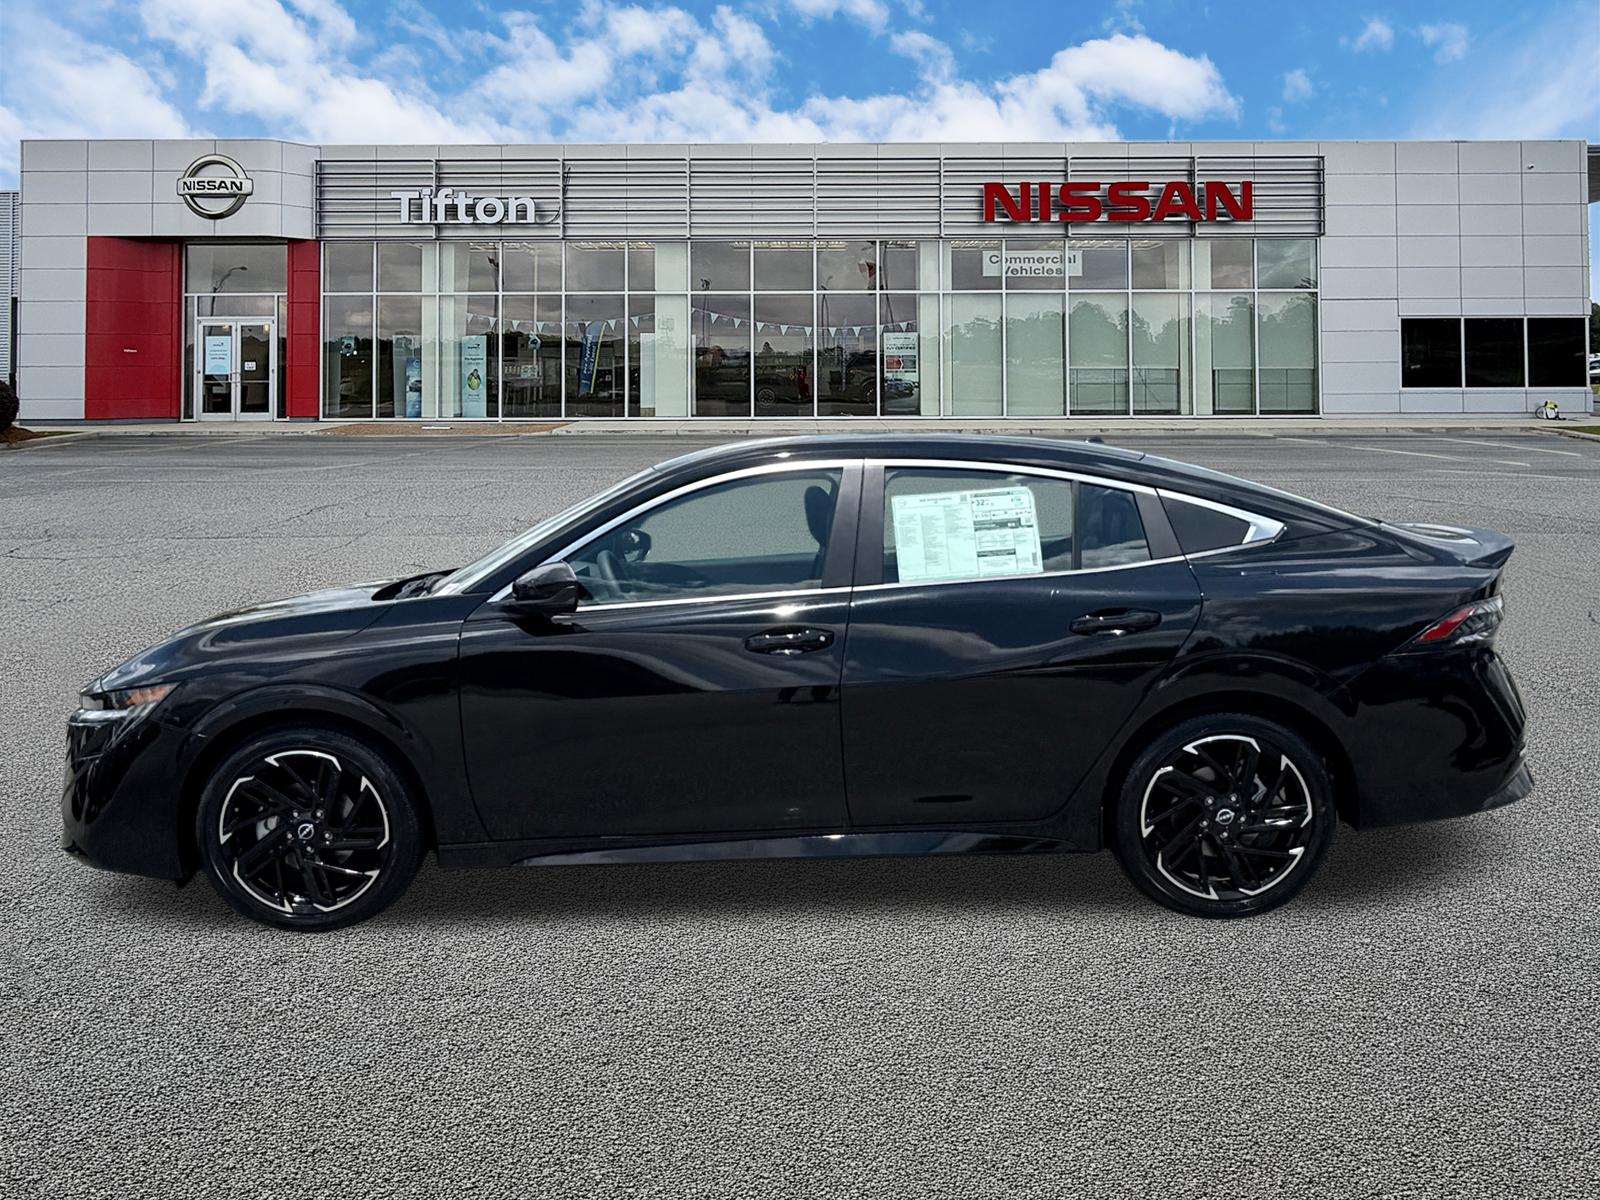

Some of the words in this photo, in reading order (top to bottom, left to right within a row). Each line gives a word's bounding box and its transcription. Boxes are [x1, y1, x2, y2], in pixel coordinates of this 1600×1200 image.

[183, 180, 243, 192] NISSAN
[983, 181, 1253, 222] NISSAN
[391, 187, 536, 224] Tifton
